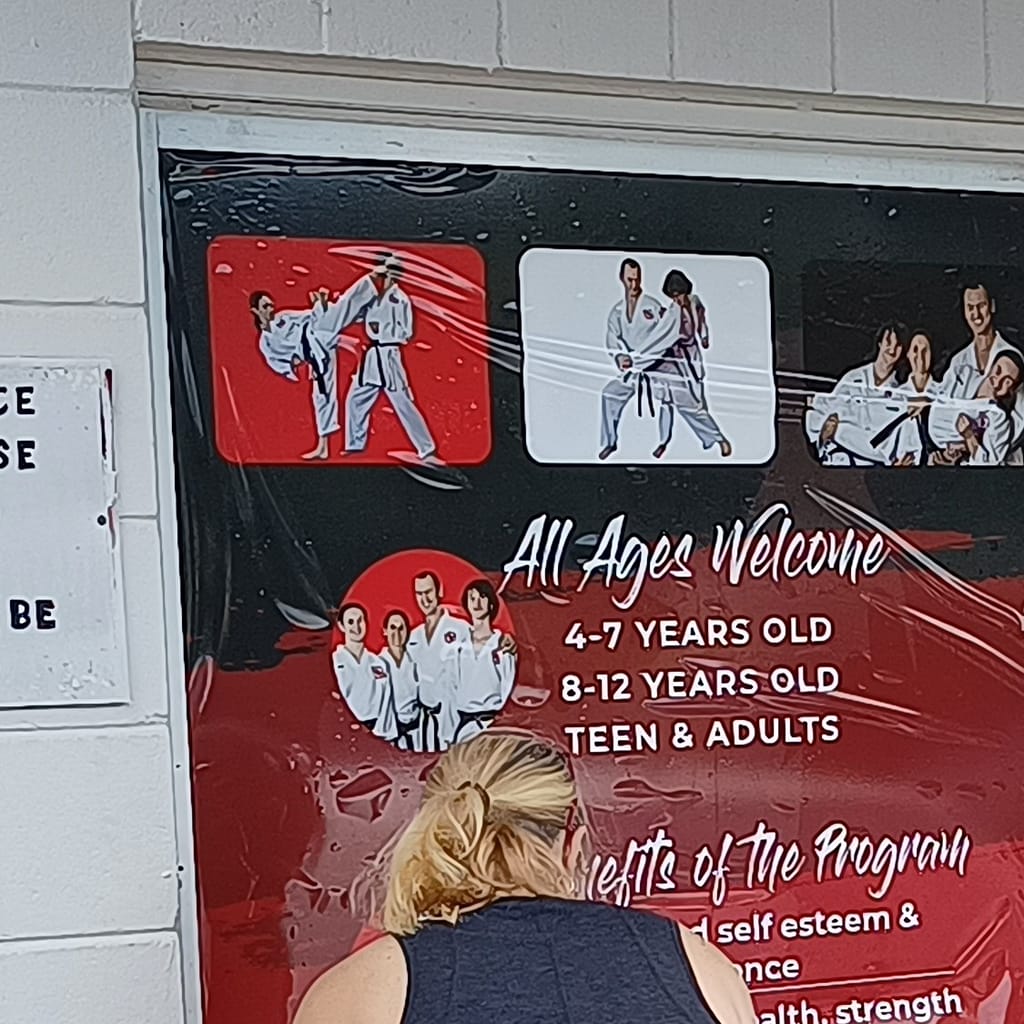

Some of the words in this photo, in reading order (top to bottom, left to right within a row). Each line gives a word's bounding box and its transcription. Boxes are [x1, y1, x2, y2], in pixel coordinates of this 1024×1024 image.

[498, 514, 574, 593] All
[576, 514, 694, 609] Ages
[711, 503, 890, 585] Welcome
[9, 599, 56, 629] BE
[564, 621, 622, 650] 4-7
[634, 618, 750, 648] YEARS
[763, 616, 832, 643] OLD
[561, 672, 631, 702] 8-12
[639, 667, 759, 699] YEARS
[770, 666, 839, 693] OLD
[564, 723, 658, 755] TEEN
[671, 722, 693, 748] &
[706, 715, 839, 747] ADULTS
[693, 834, 733, 907] of
[736, 822, 806, 892] the
[813, 823, 970, 899] Program
[717, 912, 774, 944] self
[780, 909, 890, 938] esteem
[899, 902, 920, 928] &
